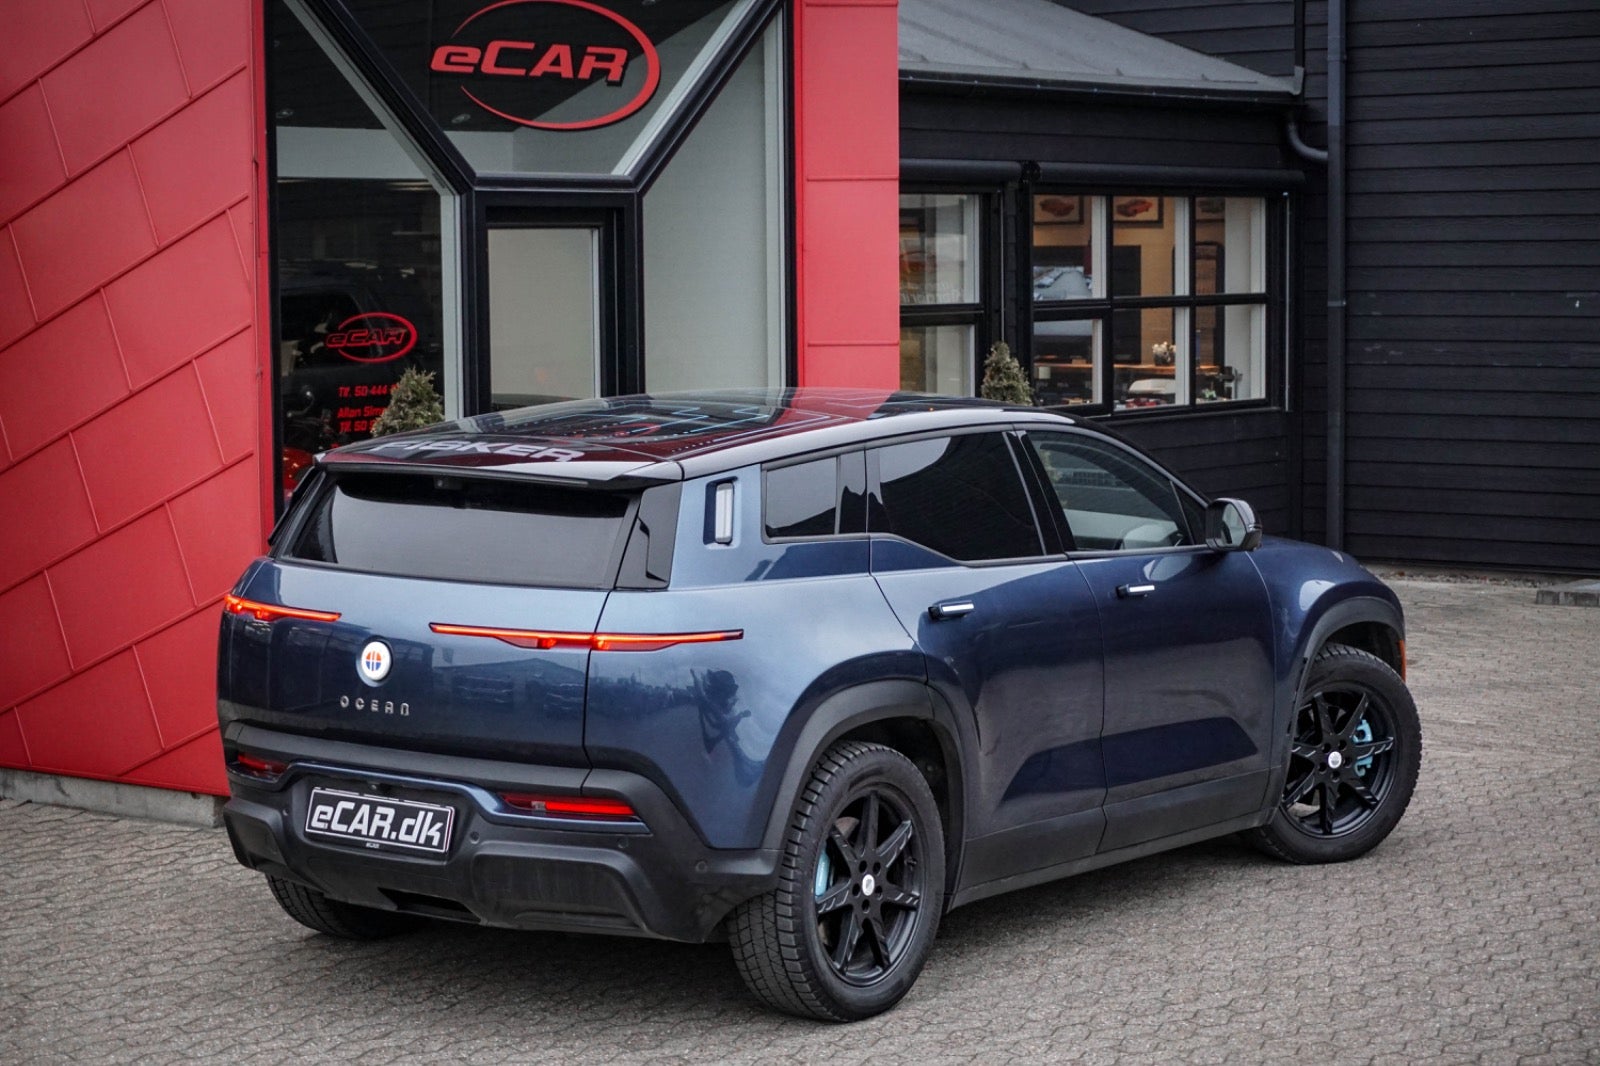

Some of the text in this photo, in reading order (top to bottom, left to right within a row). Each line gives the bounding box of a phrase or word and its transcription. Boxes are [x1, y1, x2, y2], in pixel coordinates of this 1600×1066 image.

[430, 40, 628, 81] eCAR
[326, 328, 405, 348] eCAR
[370, 441, 585, 462] FISKER
[340, 695, 410, 716] OCEAN
[311, 801, 443, 846] eCAR.dk
